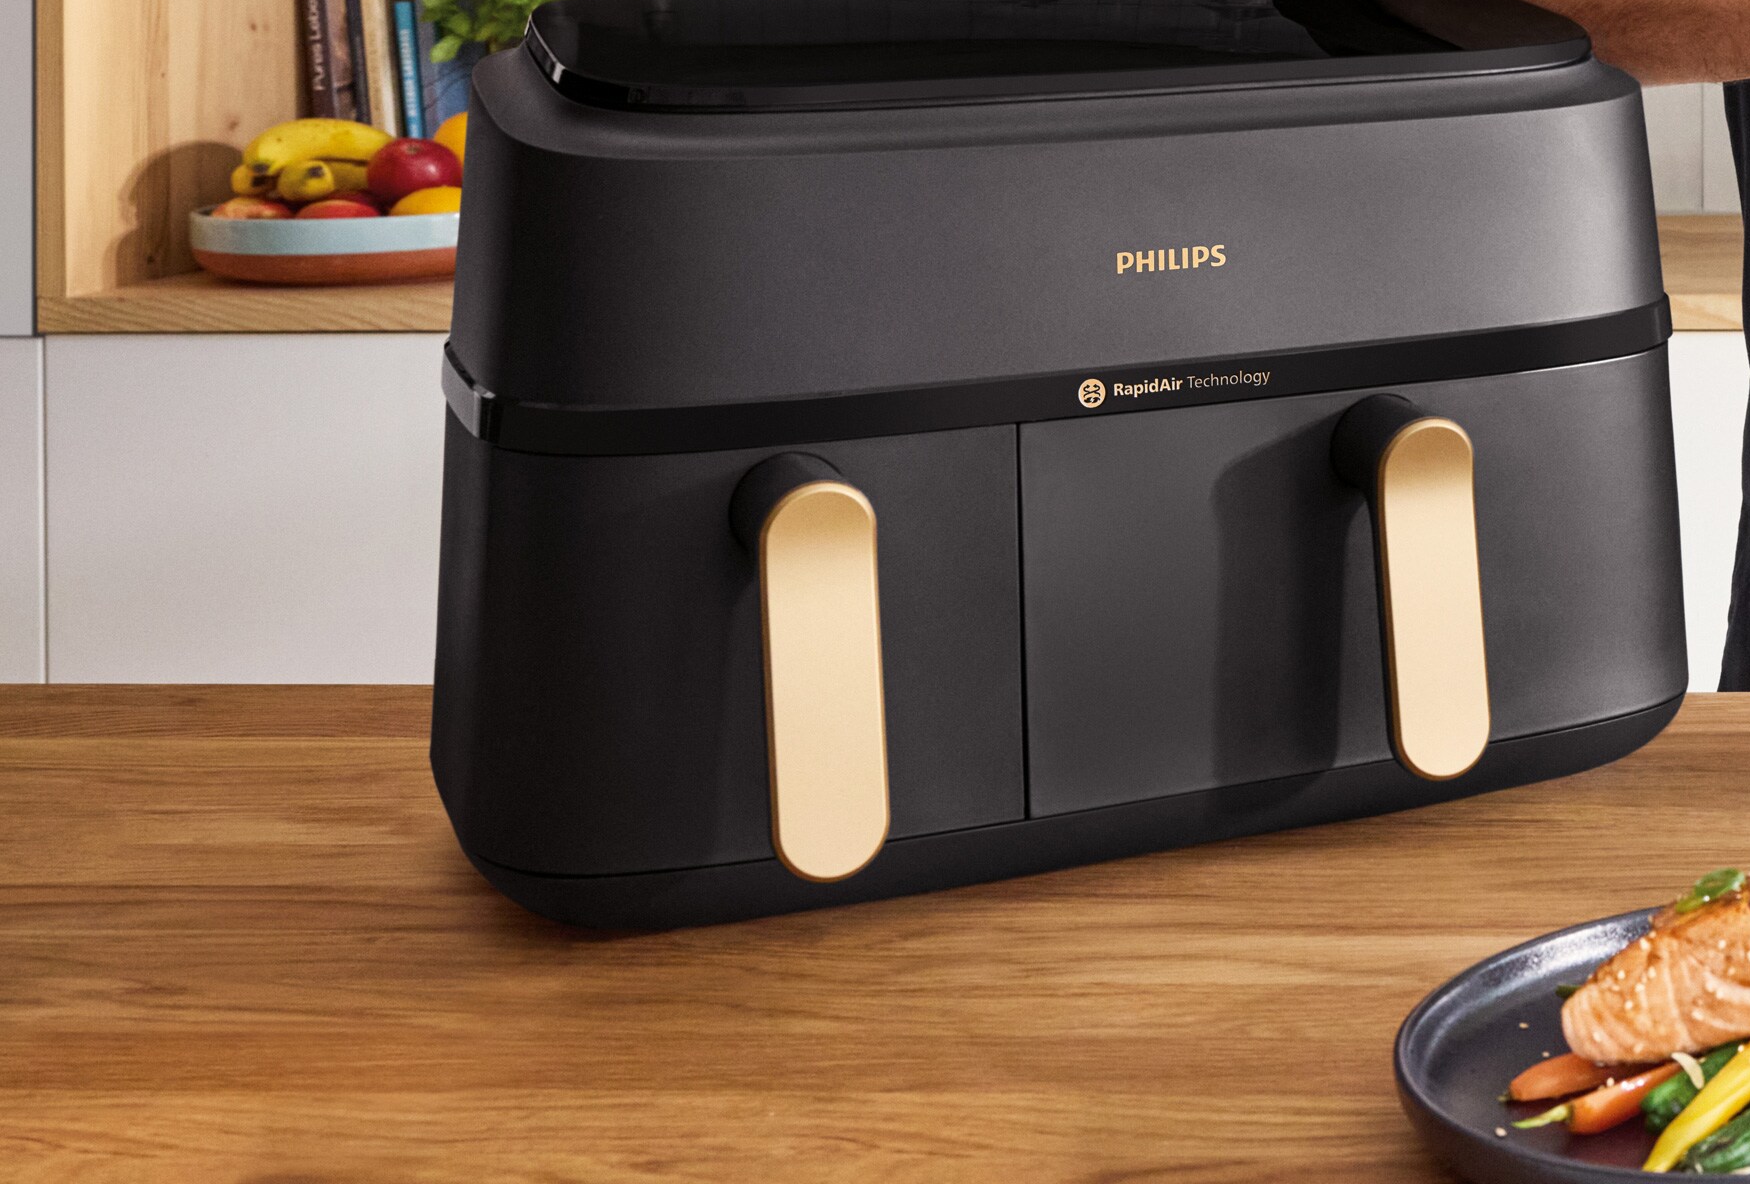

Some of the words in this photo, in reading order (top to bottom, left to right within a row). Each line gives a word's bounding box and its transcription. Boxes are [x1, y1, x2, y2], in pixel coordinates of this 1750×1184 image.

[1116, 244, 1227, 275] PHILIPS
[1113, 377, 1183, 398] RapidAir
[1187, 370, 1271, 389] Technology
